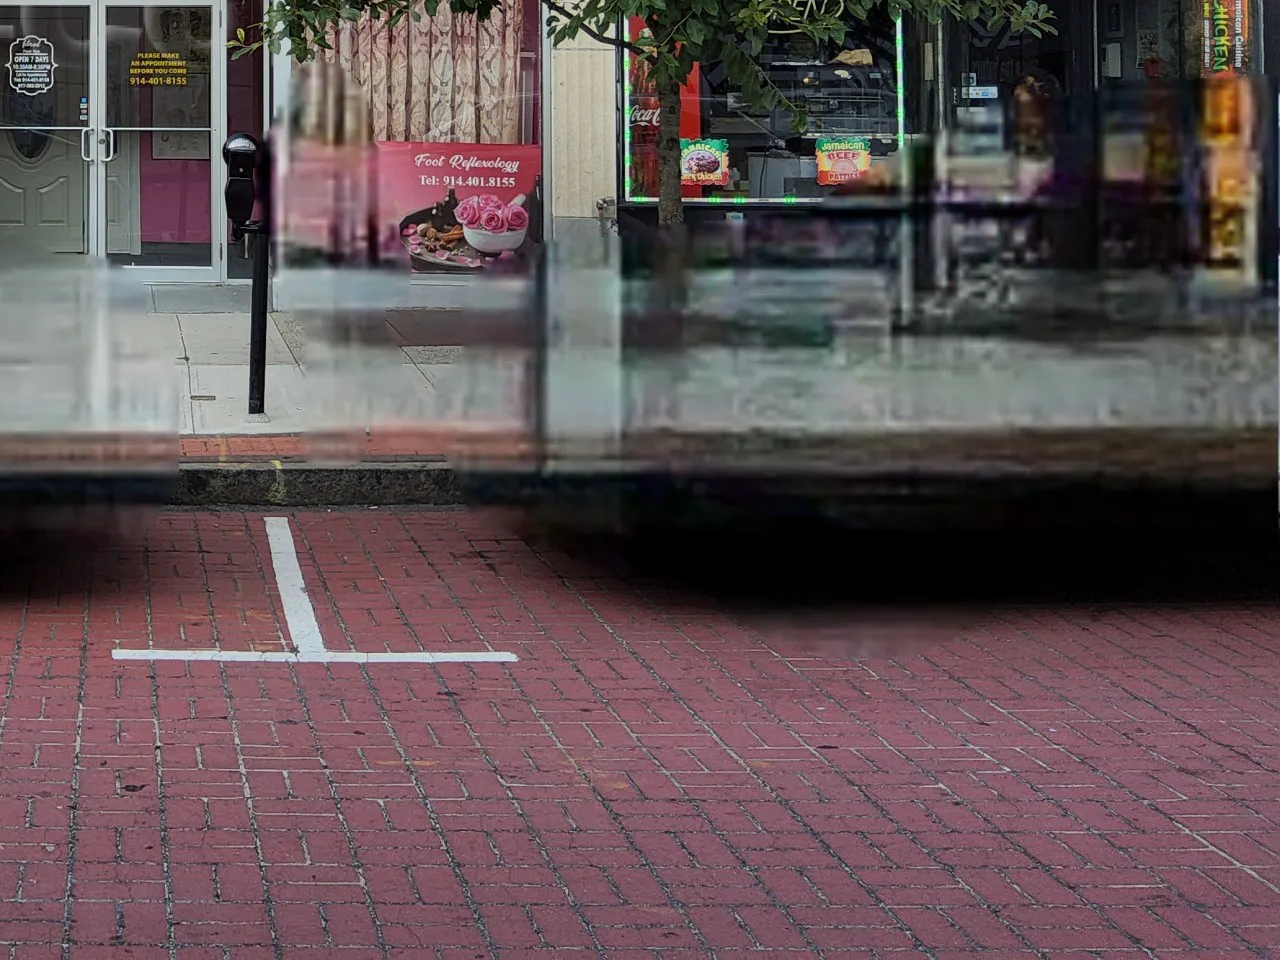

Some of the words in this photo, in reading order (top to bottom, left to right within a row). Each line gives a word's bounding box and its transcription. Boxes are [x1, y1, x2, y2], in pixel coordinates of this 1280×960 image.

[1234, 35, 1244, 68] Cuisine
[130, 77, 187, 85] 914-401-8155
[821, 141, 865, 151] Jamaican
[826, 151, 861, 160] BEEF
[414, 153, 447, 168] Foot
[449, 154, 520, 173] Reflexology
[419, 175, 440, 186] Tel:
[443, 175, 516, 187] 914.401.8155
